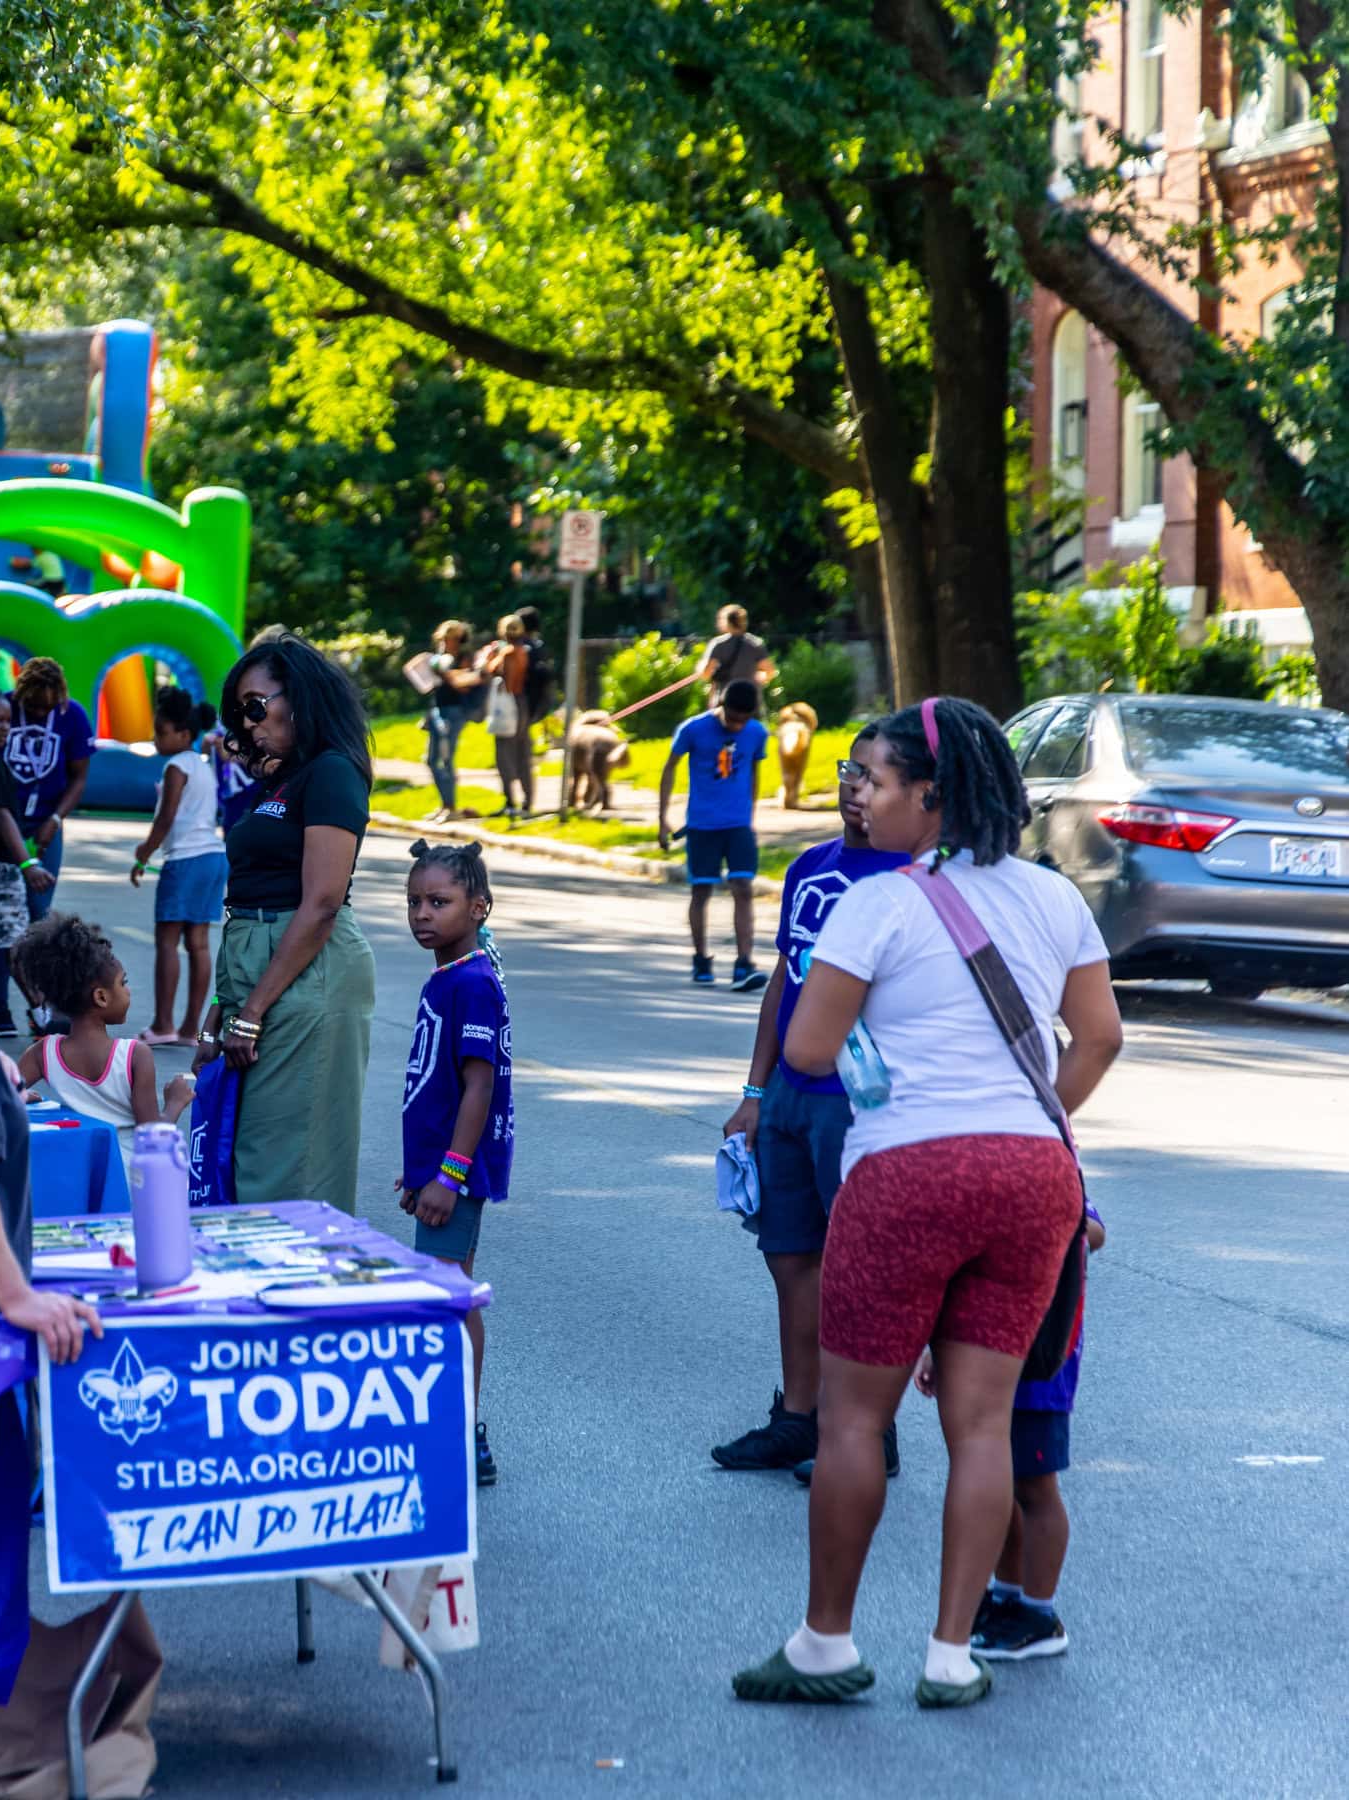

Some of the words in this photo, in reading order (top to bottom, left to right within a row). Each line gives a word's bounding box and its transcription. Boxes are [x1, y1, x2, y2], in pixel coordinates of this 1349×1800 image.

[190, 1338, 278, 1372] JOIN
[288, 1324, 445, 1365] SCOUTS
[190, 1363, 444, 1438] TODAY
[116, 1444, 415, 1490] STLBSA.ORG/JOIN
[163, 1502, 241, 1553] CAN
[252, 1504, 297, 1550] DO
[311, 1479, 410, 1541] THAT!
